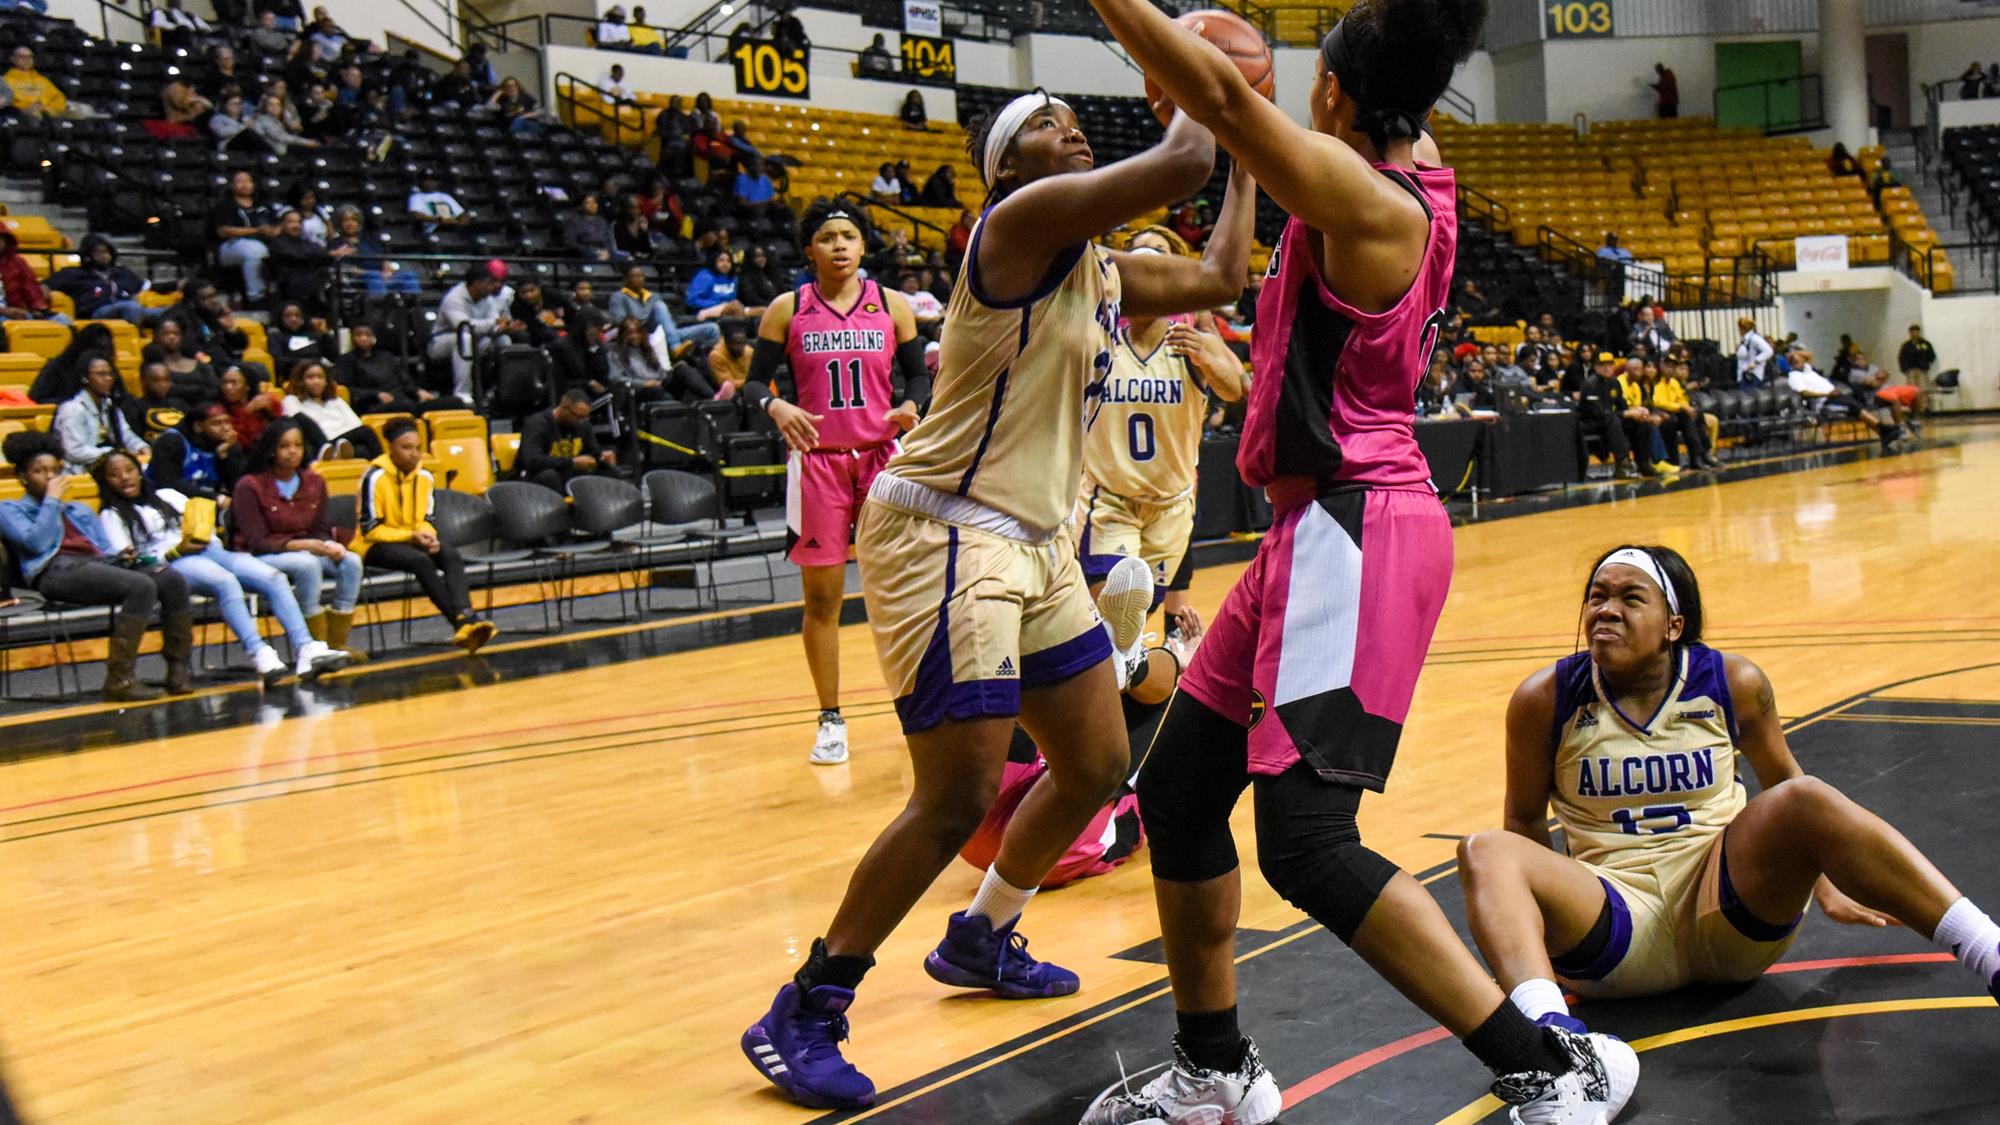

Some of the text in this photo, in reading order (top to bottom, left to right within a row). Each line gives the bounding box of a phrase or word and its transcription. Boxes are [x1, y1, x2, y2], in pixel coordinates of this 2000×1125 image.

[1548, 1, 1612, 34] 103
[735, 43, 808, 94] 105
[901, 38, 955, 79] 104
[803, 330, 885, 353] GRAMBLING
[826, 358, 867, 410] 11
[1101, 377, 1183, 405] ALCORN
[1127, 412, 1156, 462] 0
[1578, 748, 1715, 798] ALCORN
